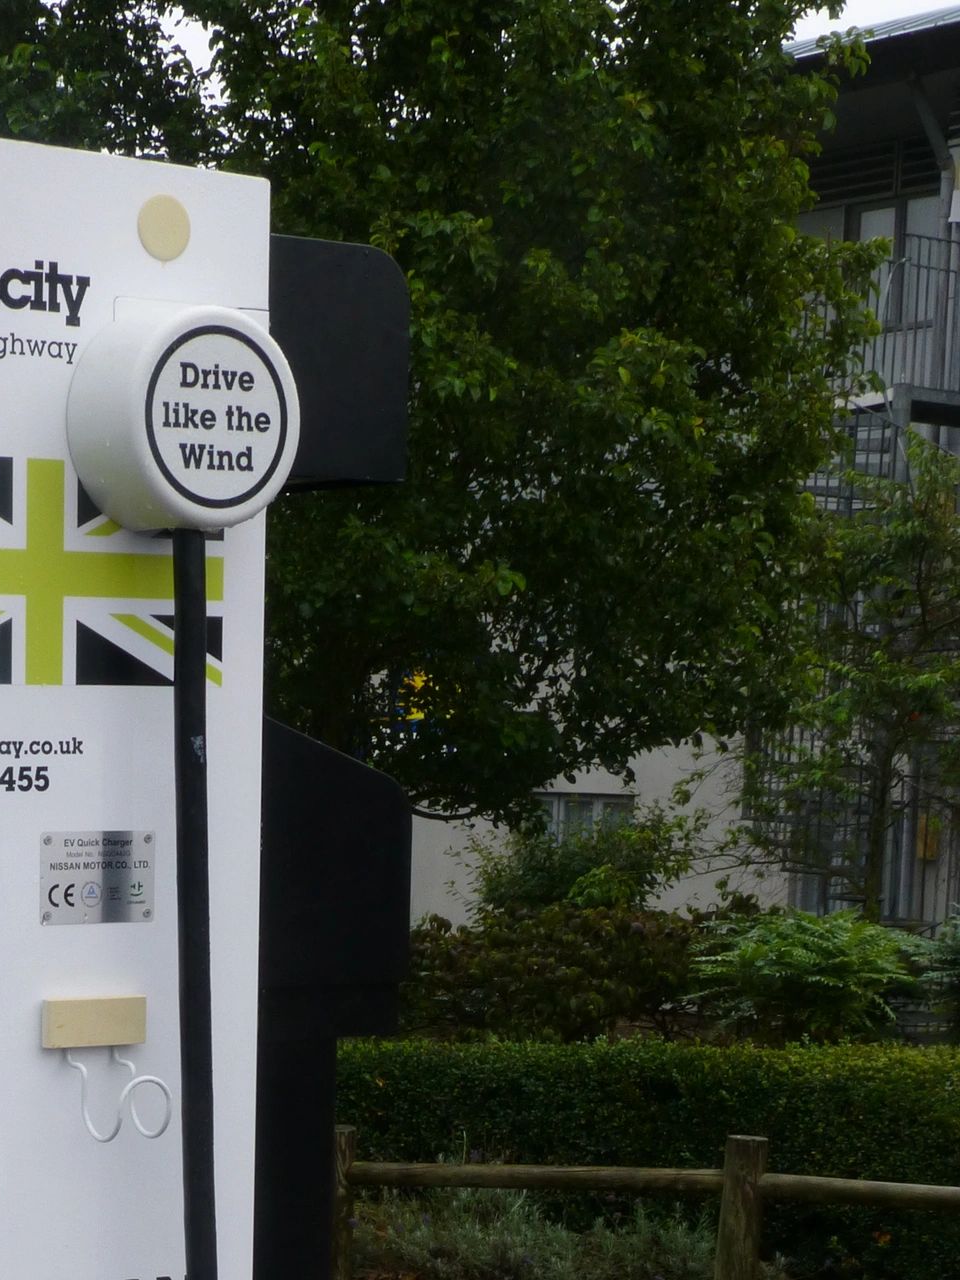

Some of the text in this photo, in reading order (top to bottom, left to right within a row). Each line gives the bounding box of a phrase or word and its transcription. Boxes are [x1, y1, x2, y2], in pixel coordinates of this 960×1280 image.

[179, 361, 255, 393] Drive
[162, 401, 272, 434] like the
[178, 442, 254, 473] Wind
[64, 838, 133, 848] EV Quick Charger
[50, 861, 81, 871] NISSAN
[83, 861, 113, 870] MOTOR
